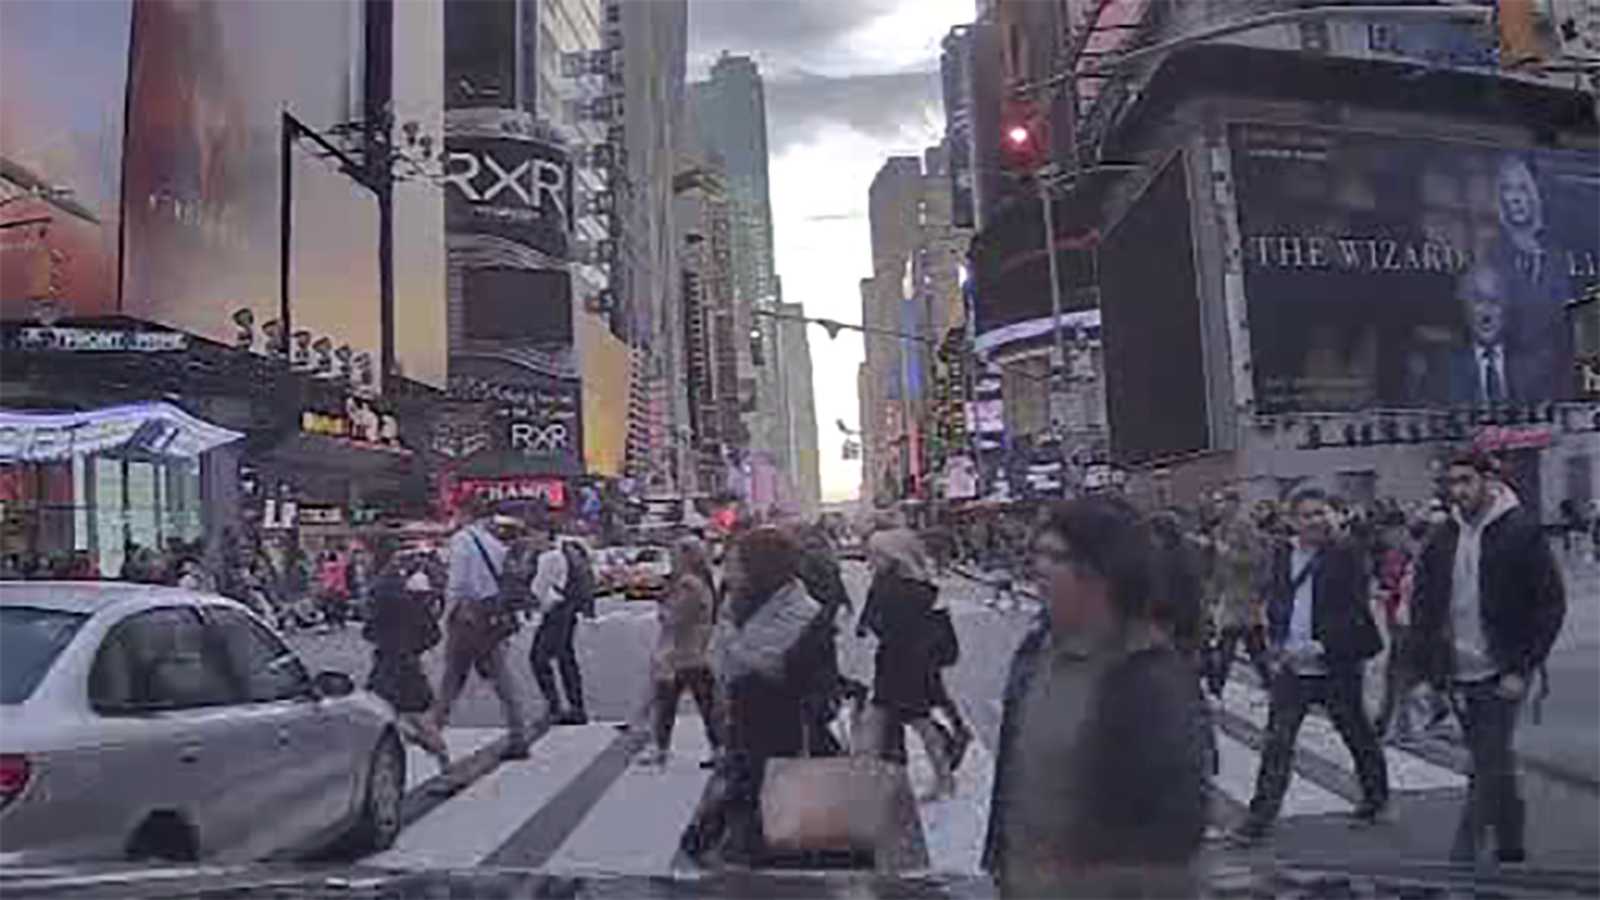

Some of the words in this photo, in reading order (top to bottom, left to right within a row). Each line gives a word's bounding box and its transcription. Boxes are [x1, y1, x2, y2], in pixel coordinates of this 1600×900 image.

[446, 152, 566, 218] RXR
[1250, 237, 1329, 267] THE
[1338, 239, 1465, 273] WIZARD
[511, 423, 567, 450] RXR
